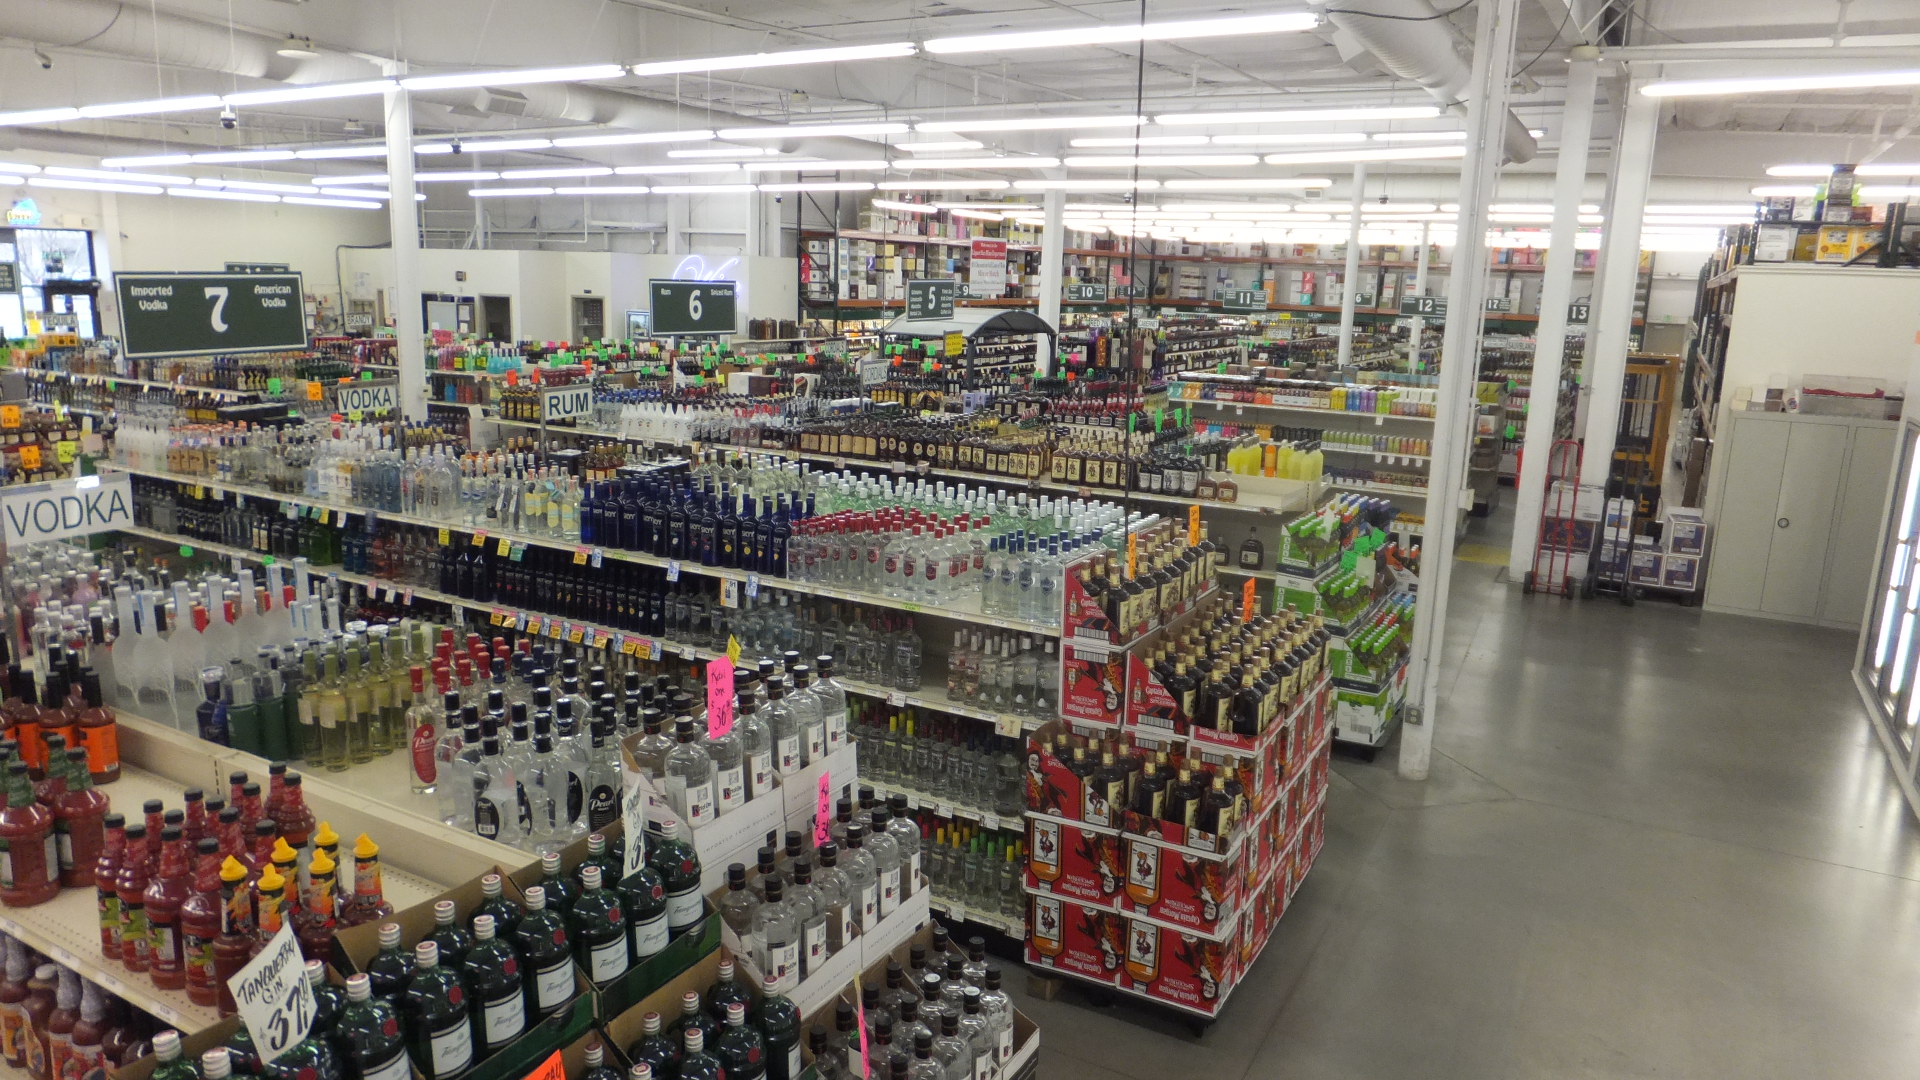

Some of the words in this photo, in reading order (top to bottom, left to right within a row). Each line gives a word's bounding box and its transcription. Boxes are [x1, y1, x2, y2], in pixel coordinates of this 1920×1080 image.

[131, 285, 173, 297] Imported
[254, 284, 291, 294] American
[963, 285, 969, 296] 9
[1081, 286, 1093, 298] 10
[261, 298, 287, 308] Vodka
[928, 286, 936, 310] 5
[1240, 292, 1251, 304] 11
[1488, 299, 1499, 309] 17
[138, 300, 168, 311] Vodka
[204, 286, 229, 332] 7
[689, 289, 703, 321] 6
[1418, 299, 1433, 312] 12
[1572, 306, 1587, 320] 13
[340, 387, 392, 410] VODKA
[549, 392, 588, 416] RUM
[6, 489, 129, 537] VODKA
[590, 797, 614, 811] Pearl
[262, 976, 284, 1004] GIN
